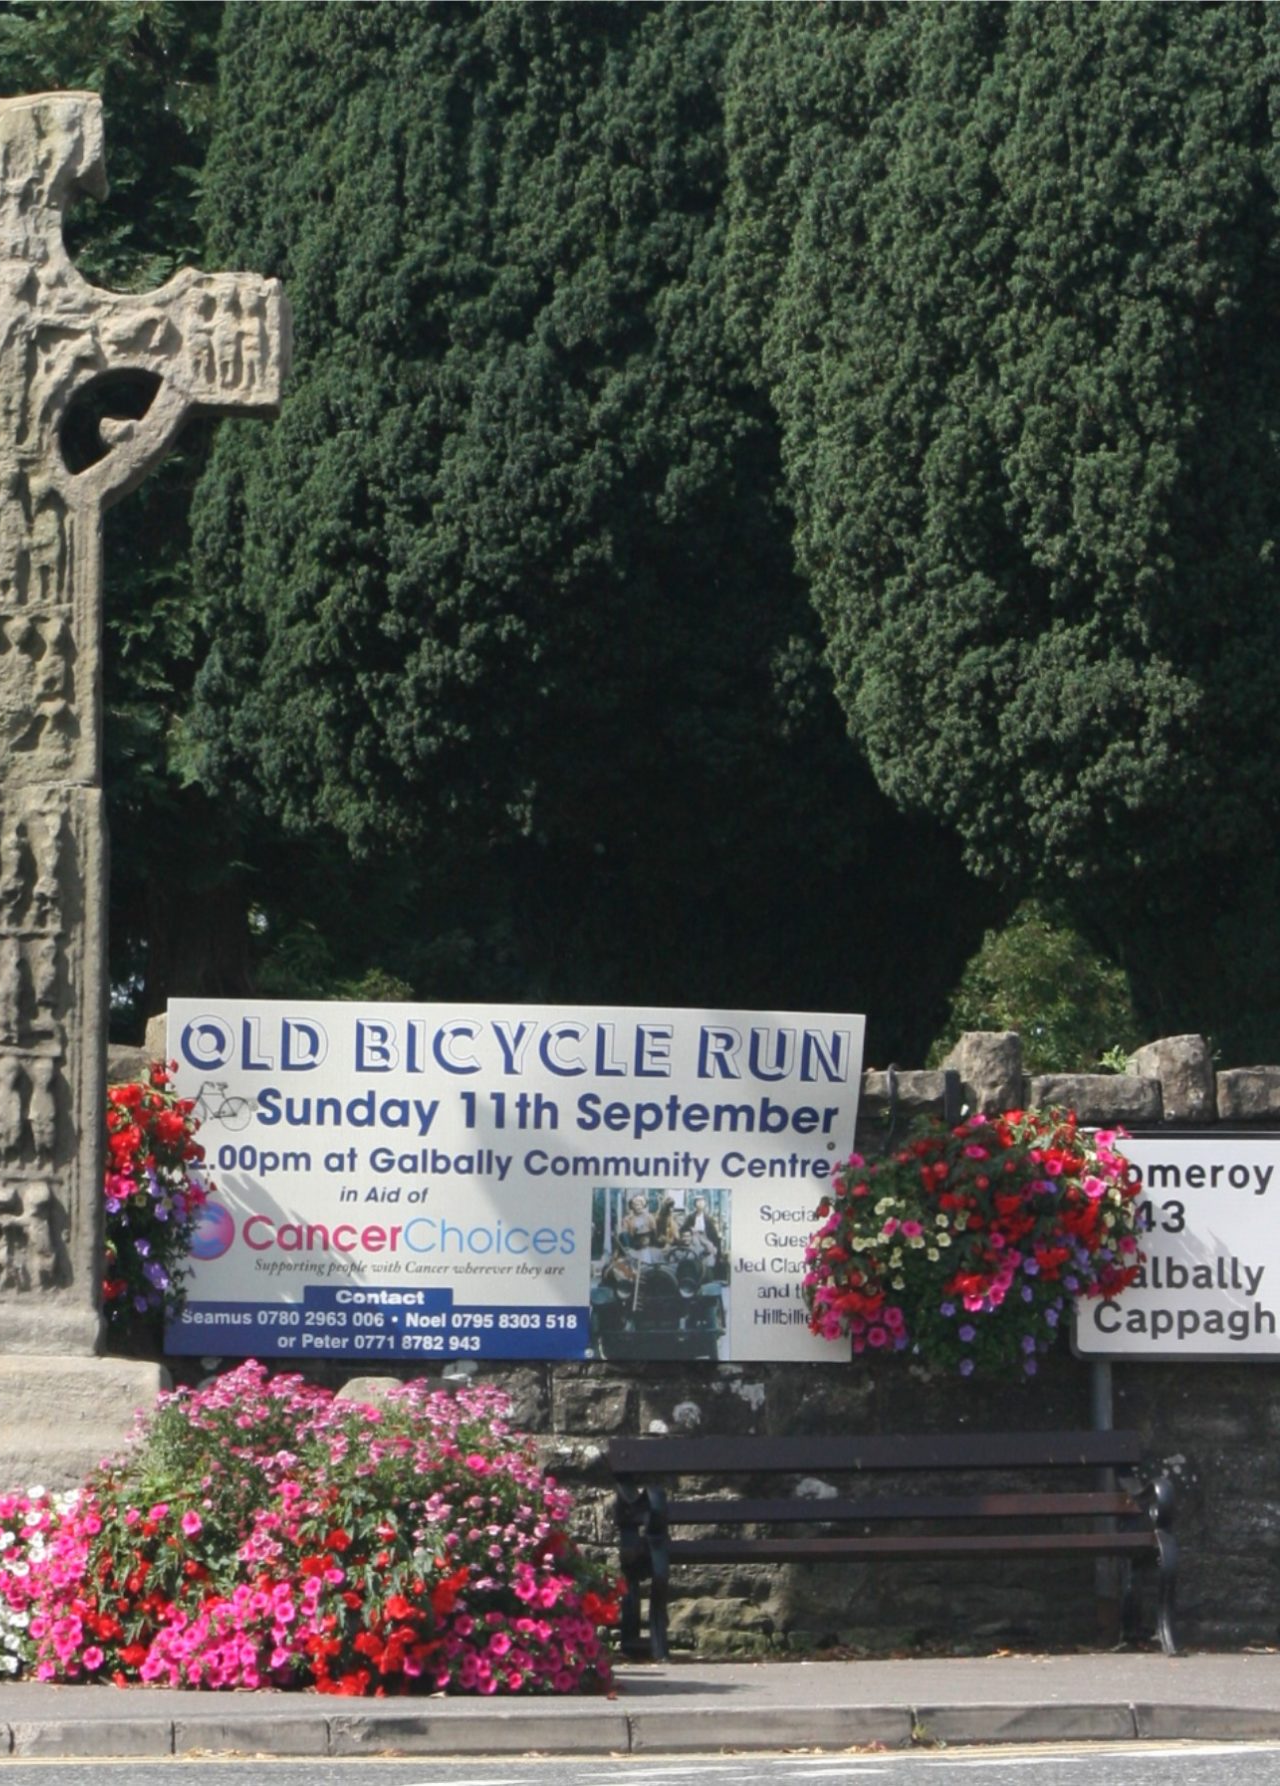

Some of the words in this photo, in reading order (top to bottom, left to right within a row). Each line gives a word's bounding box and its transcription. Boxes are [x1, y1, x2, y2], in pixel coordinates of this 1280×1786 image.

[180, 1014, 329, 1071] OLD
[355, 1018, 673, 1078] BICYCLE
[697, 1025, 851, 1082] RUN
[255, 1087, 440, 1136] Sunday
[460, 1091, 559, 1130] 11th
[576, 1092, 839, 1140] September
[323, 1147, 358, 1173] at
[370, 1147, 513, 1181] Galbally
[524, 1149, 710, 1183] Community
[721, 1152, 831, 1180] Centre
[1125, 1163, 1275, 1196] omeroy
[339, 1186, 358, 1202] in
[365, 1187, 401, 1203] Aid
[407, 1187, 429, 1203] of
[759, 1204, 819, 1225] Specia
[242, 1214, 577, 1255] CancerChoices
[254, 1258, 326, 1278] Supporting
[327, 1262, 368, 1278] people
[371, 1261, 401, 1274] with
[405, 1261, 450, 1275] Cancer
[453, 1262, 513, 1276] wherever
[515, 1262, 543, 1280] they
[544, 1266, 565, 1276] are
[733, 1257, 766, 1273] Jed
[1132, 1256, 1266, 1297] albally
[335, 1289, 425, 1306] Contact
[757, 1283, 790, 1299] and
[181, 1309, 252, 1326] Seamus
[257, 1310, 300, 1326] 0780
[304, 1311, 348, 1327] 2963
[352, 1312, 385, 1327] 006
[405, 1312, 447, 1328] Noel
[451, 1313, 494, 1329] 0795
[498, 1313, 541, 1329] 8303
[545, 1313, 578, 1329] 518
[1093, 1301, 1276, 1341] Cappagh
[277, 1337, 297, 1348] or
[302, 1333, 349, 1349] Peter
[354, 1334, 396, 1349] 0771
[401, 1335, 444, 1350] 8782
[448, 1335, 481, 1351] 943
